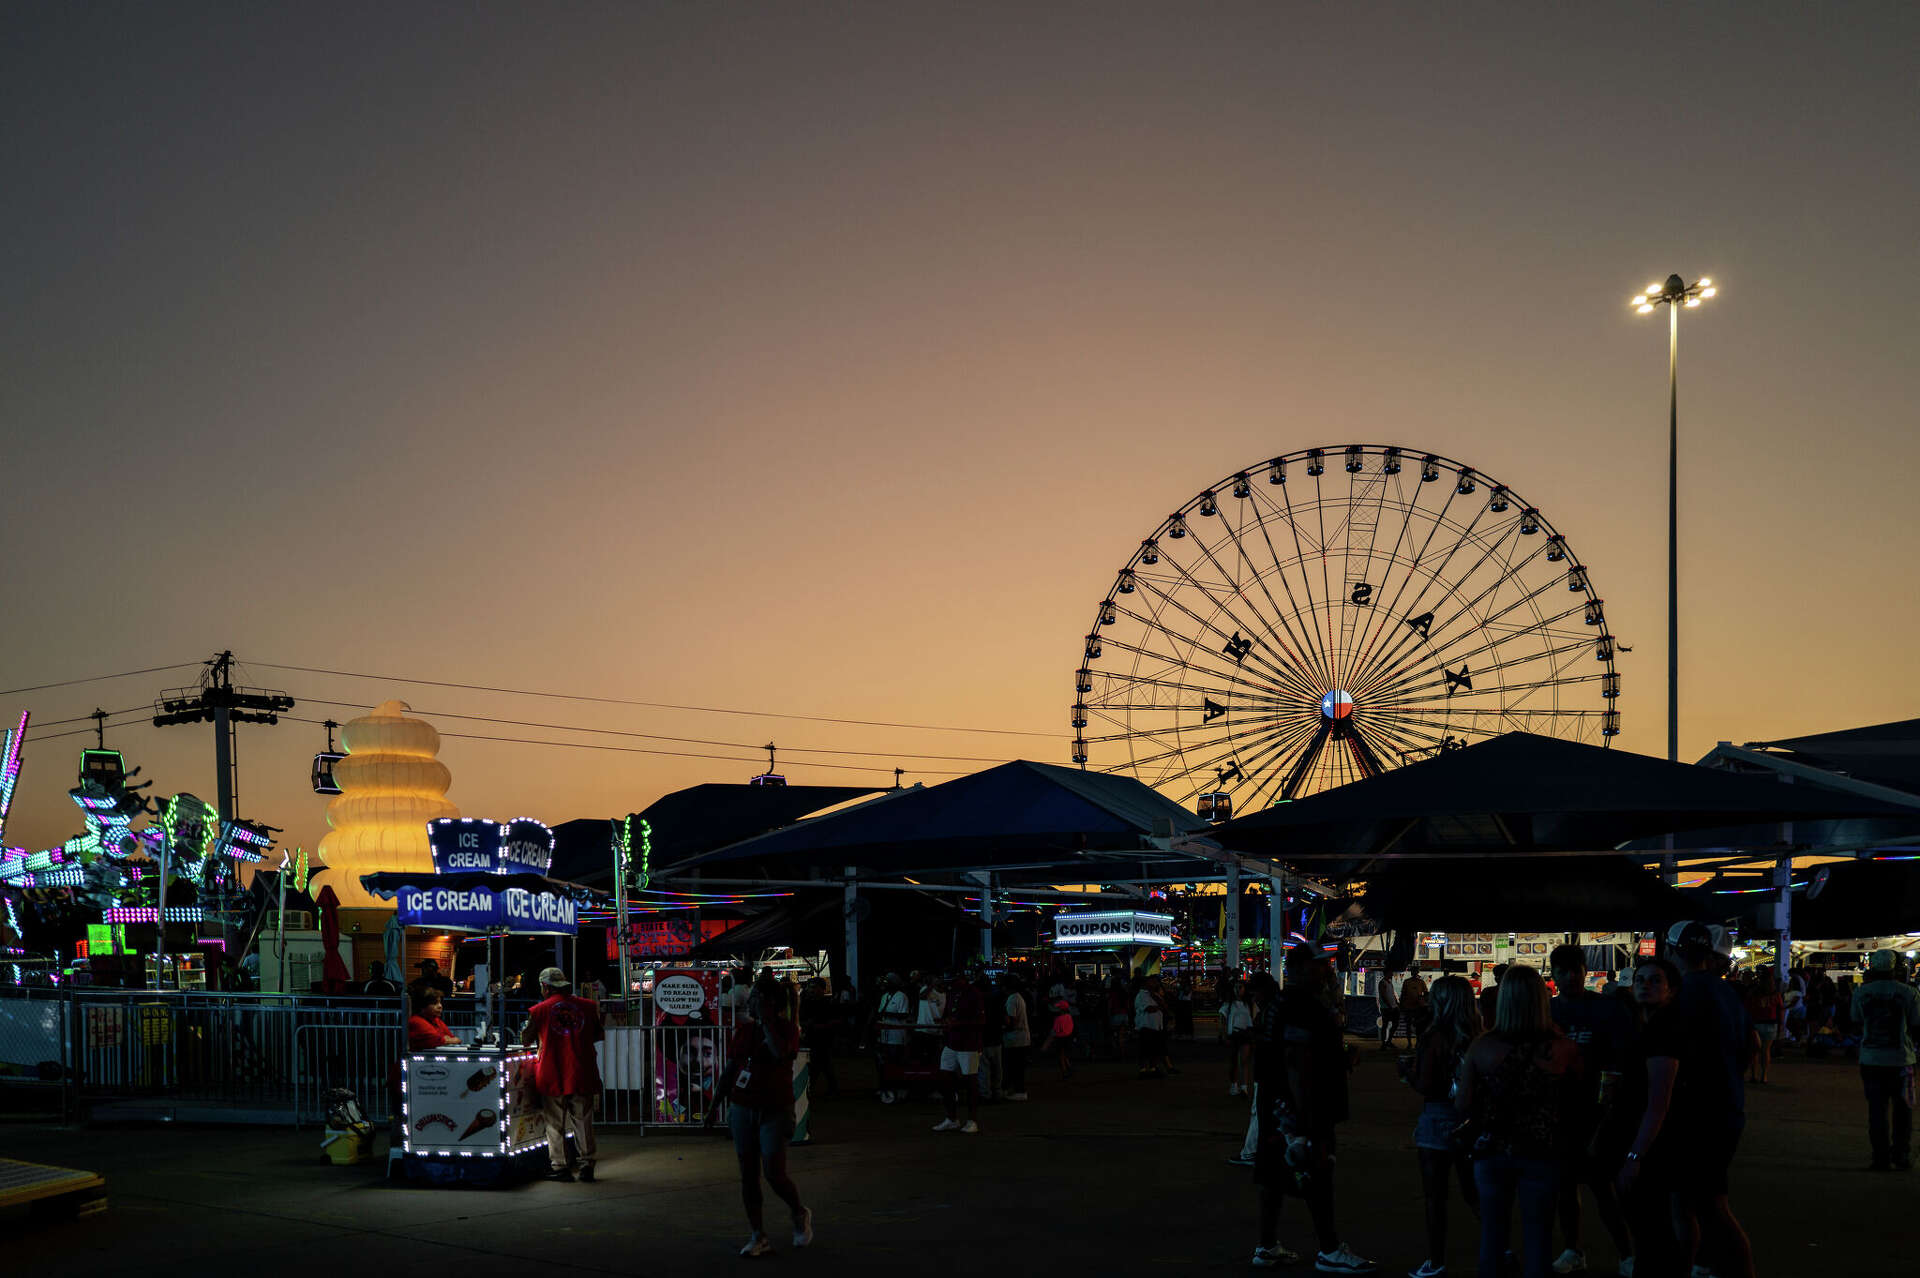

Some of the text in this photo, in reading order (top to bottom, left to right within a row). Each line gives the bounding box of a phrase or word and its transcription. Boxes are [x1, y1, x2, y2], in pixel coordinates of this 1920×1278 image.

[458, 832, 480, 848] ICE
[448, 852, 491, 868] CREAM
[507, 840, 548, 870] ICE CREAM
[406, 891, 493, 911] ICE CREAM
[506, 890, 574, 925] ICE CREAM
[1059, 921, 1131, 936] COUPONS
[1134, 921, 1170, 936] COUPONS
[631, 944, 689, 956] CAND
